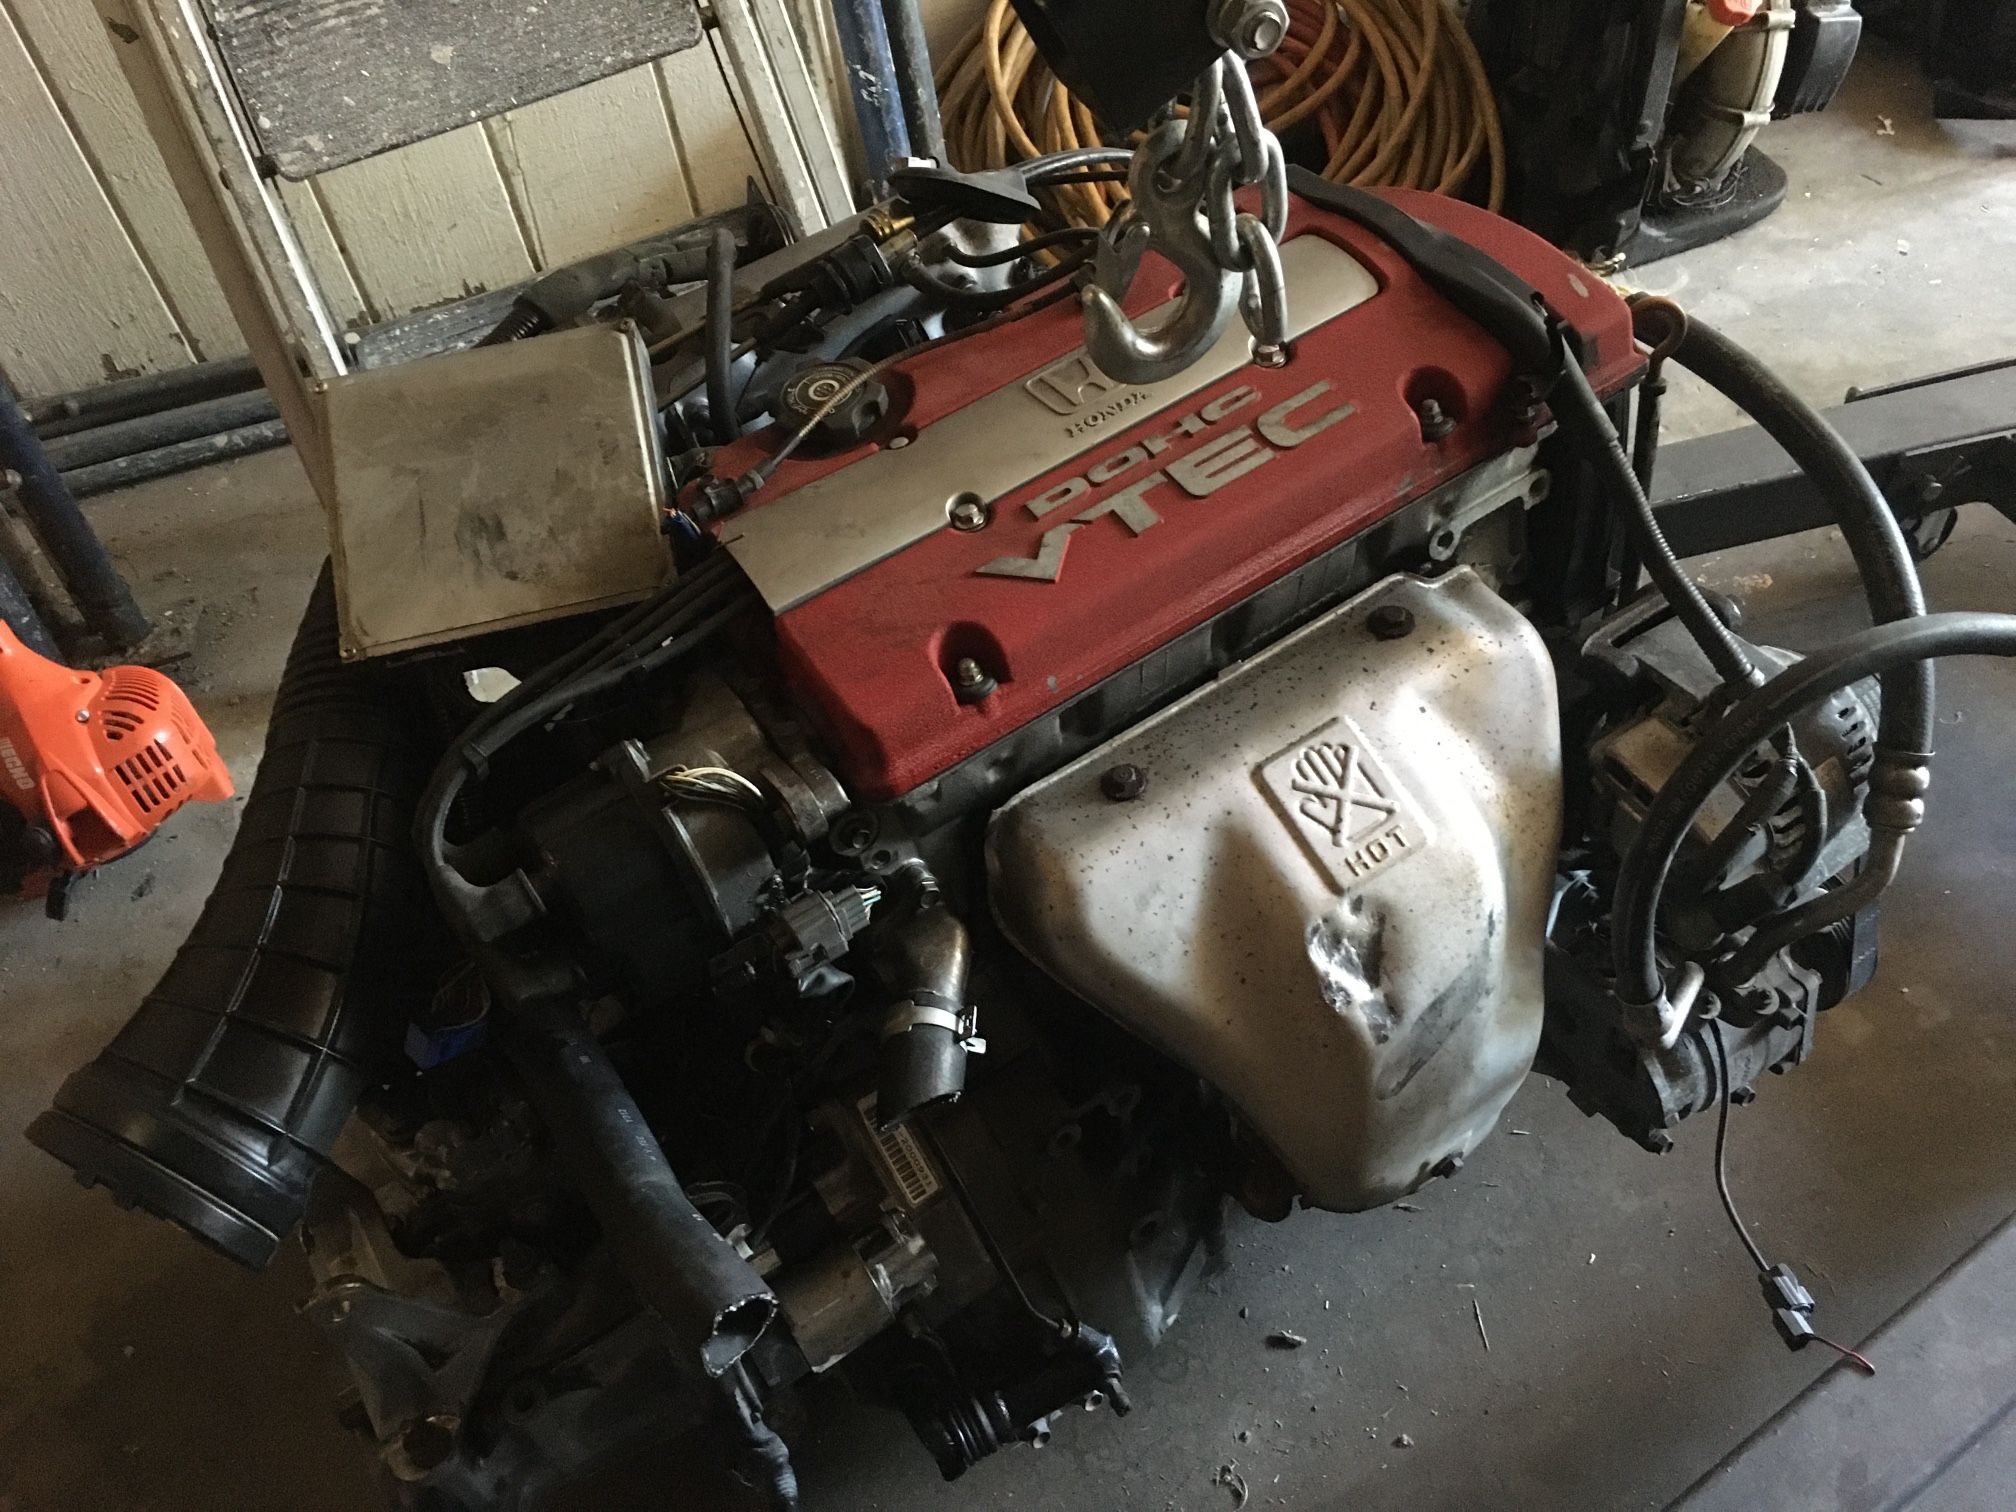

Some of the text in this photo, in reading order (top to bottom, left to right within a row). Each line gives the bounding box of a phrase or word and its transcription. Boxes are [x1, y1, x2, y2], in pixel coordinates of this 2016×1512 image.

[1024, 385, 1261, 522] DOHC
[1064, 391, 1147, 438] HONDA
[974, 380, 1356, 583] VTEC
[1344, 825, 1407, 877] HOT
